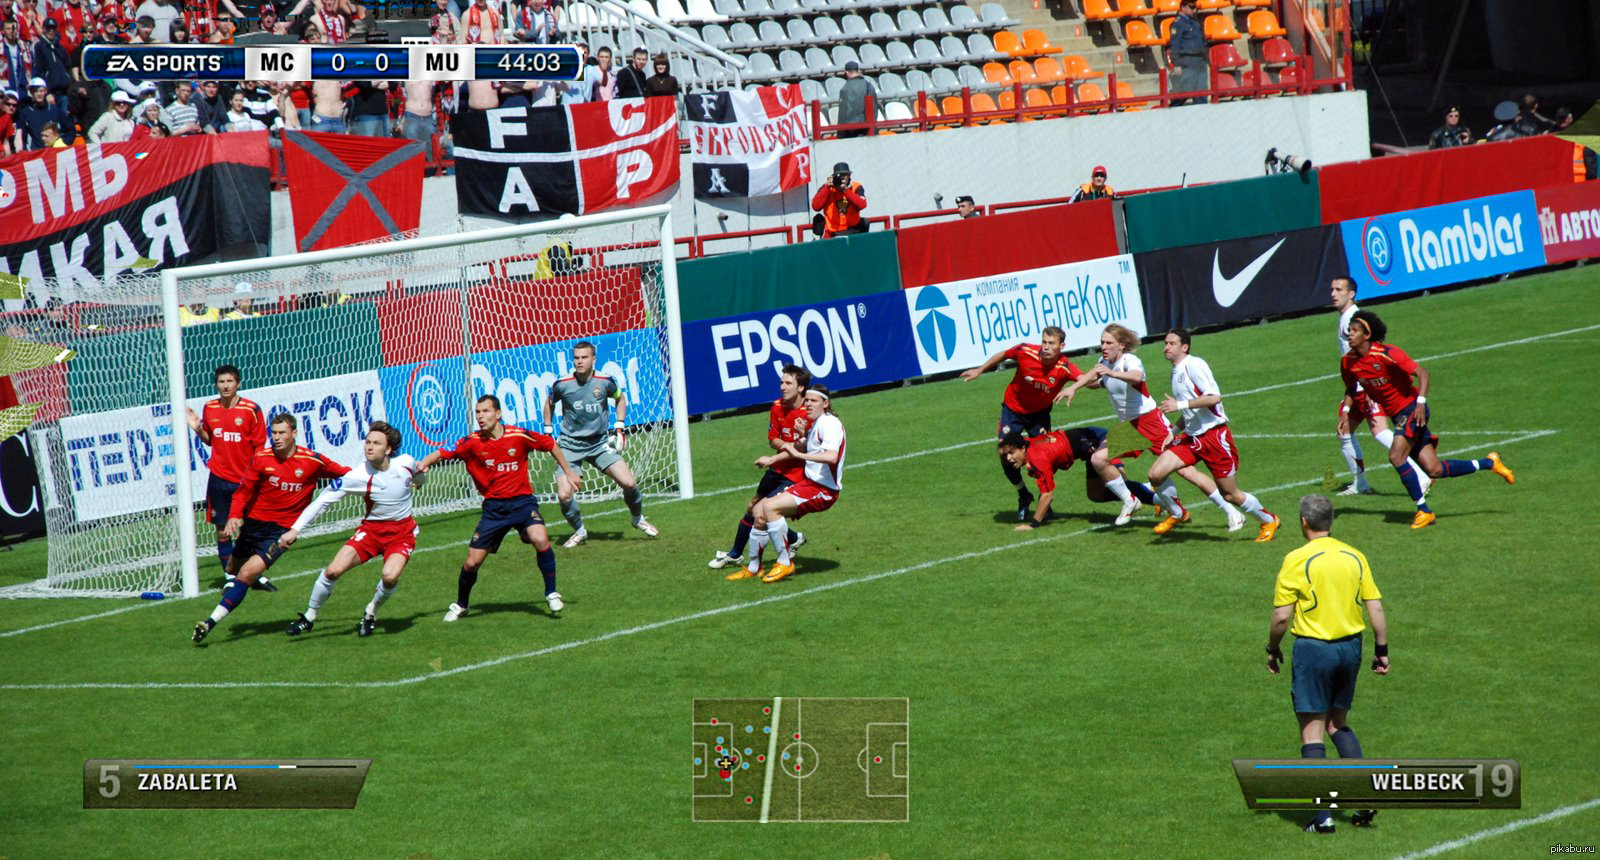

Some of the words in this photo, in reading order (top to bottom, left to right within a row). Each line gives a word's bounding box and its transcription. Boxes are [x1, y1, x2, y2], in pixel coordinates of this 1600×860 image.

[486, 106, 527, 149] F
[700, 94, 719, 119] F
[499, 166, 540, 213] A
[1399, 204, 1524, 273] Rambler
[975, 277, 1020, 297] компания
[957, 274, 1127, 356] ТрансТелеКом
[223, 431, 242, 442] ВТБ
